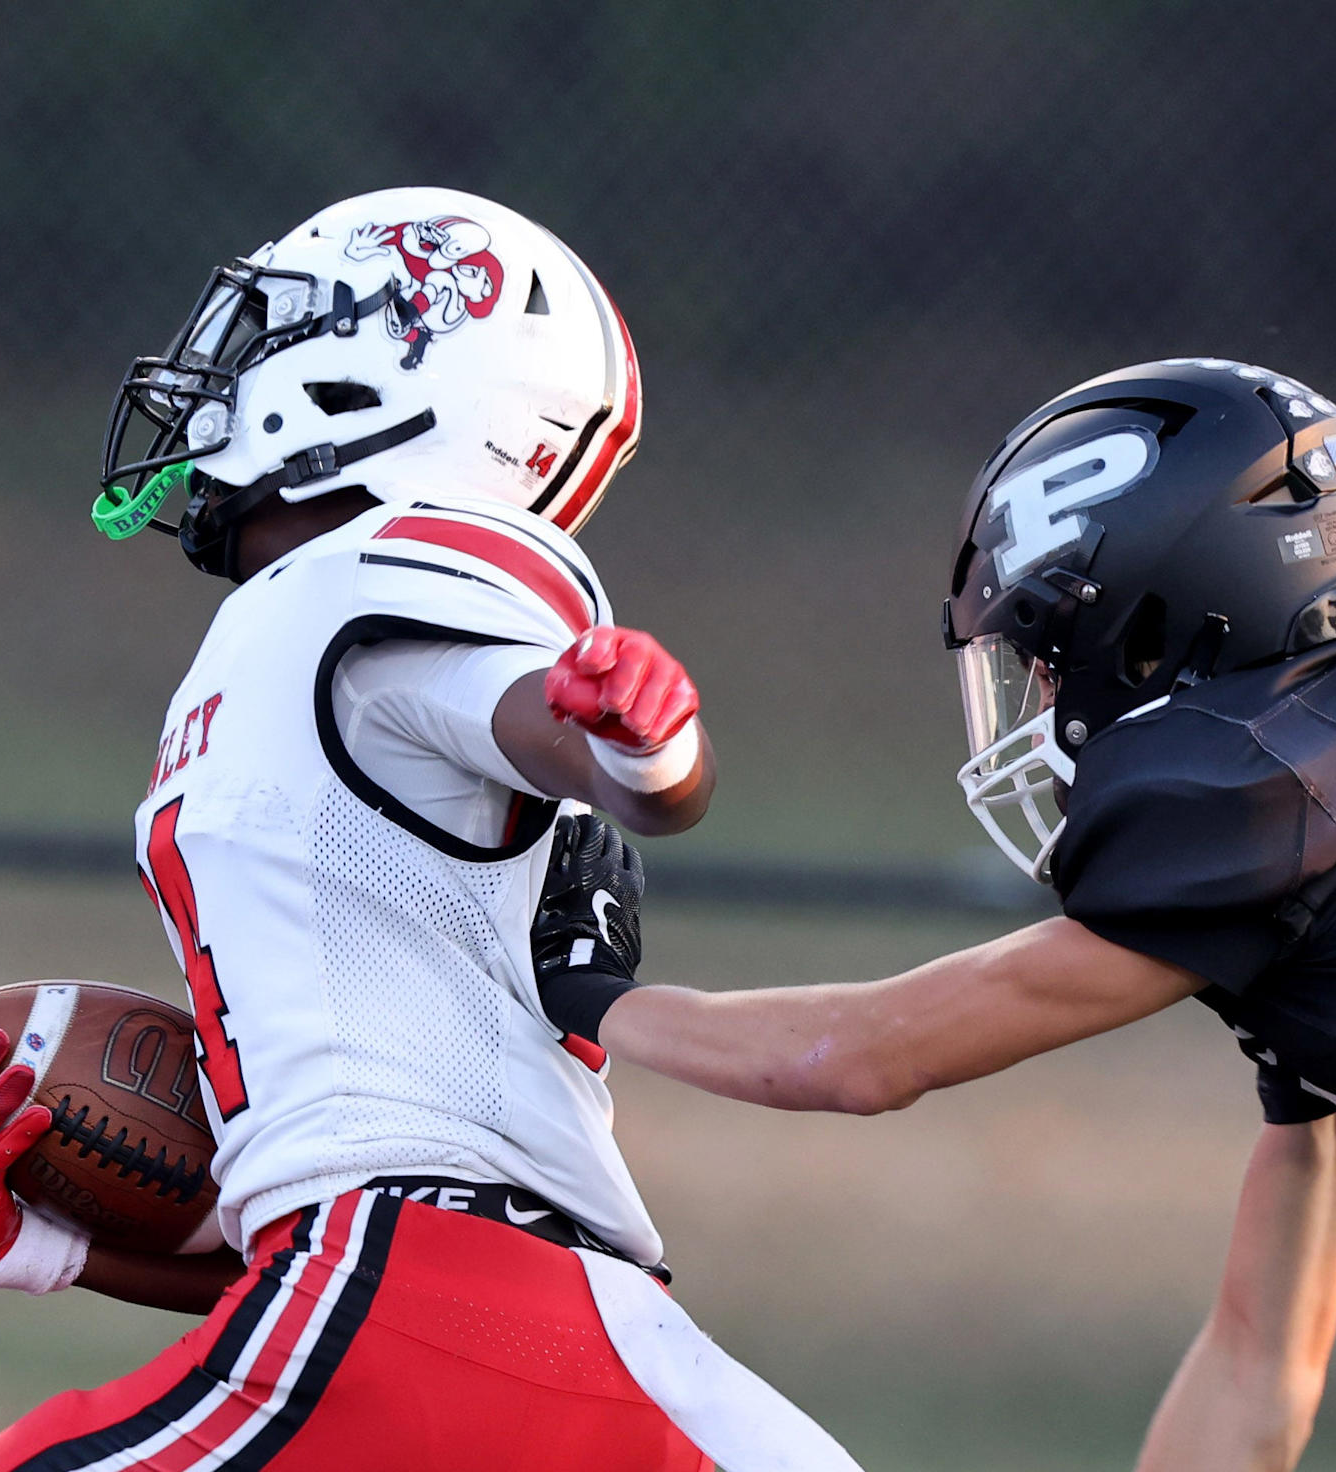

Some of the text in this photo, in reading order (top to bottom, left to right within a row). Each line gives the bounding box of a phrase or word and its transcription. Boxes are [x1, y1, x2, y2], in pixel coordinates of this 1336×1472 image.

[485, 440, 519, 467] Riddell
[525, 443, 558, 478] 14
[113, 470, 180, 532] BATTLE
[992, 432, 1148, 576] P
[137, 793, 250, 1124] 4
